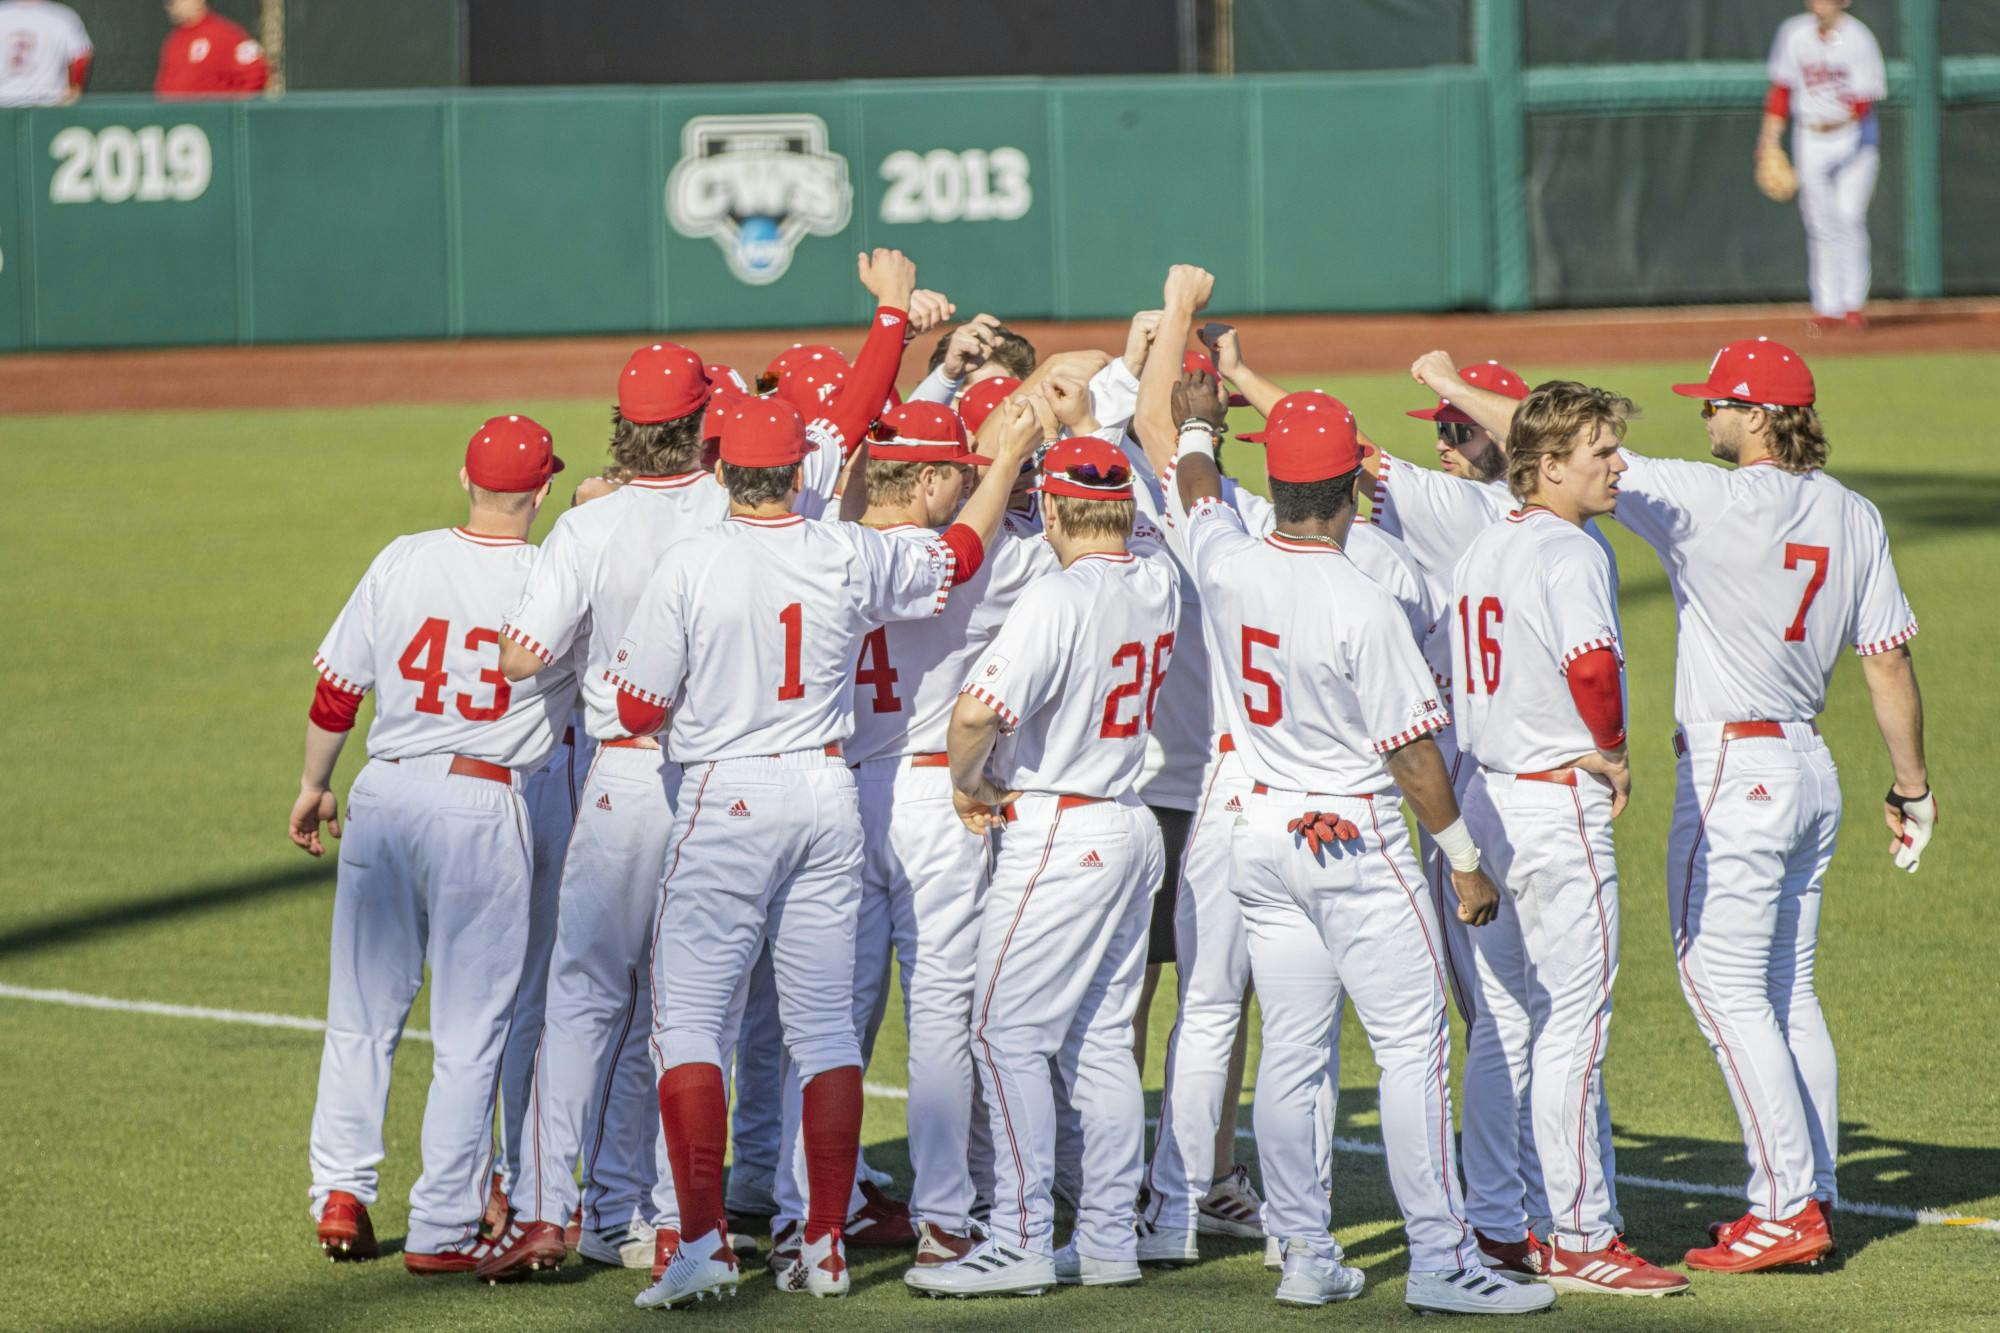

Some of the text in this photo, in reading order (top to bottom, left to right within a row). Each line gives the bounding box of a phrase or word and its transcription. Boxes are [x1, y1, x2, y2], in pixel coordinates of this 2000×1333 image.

[49, 124, 212, 204] 2019
[672, 152, 850, 230] CWS
[879, 147, 1032, 223] 2013
[1784, 542, 1829, 642] 7
[398, 617, 512, 722] 43
[778, 603, 805, 701] 1
[855, 624, 902, 714] 4
[1241, 624, 1283, 728] 5
[1459, 595, 1503, 696] 16
